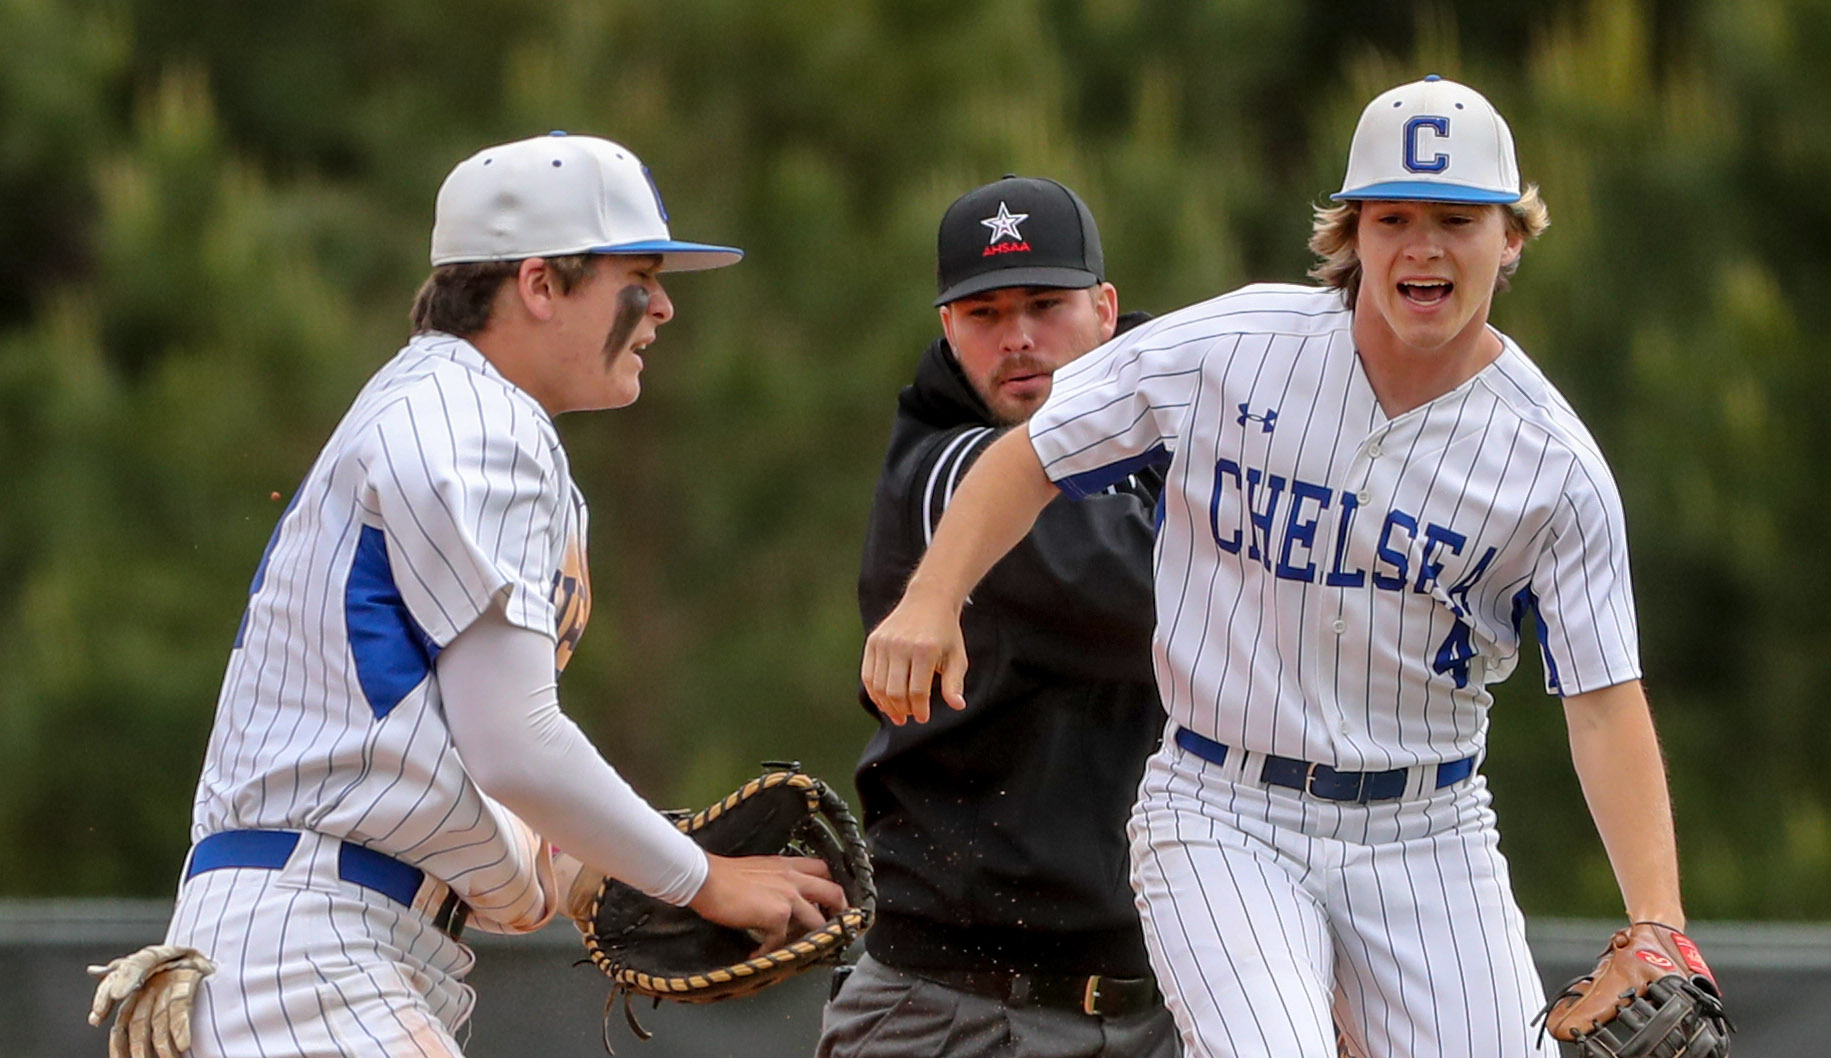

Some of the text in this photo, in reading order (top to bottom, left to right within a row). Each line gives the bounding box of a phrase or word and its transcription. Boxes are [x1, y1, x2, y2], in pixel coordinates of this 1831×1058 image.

[1402, 115, 1450, 174] C
[982, 241, 1032, 256] AHSAA
[1433, 619, 1478, 690] 4
